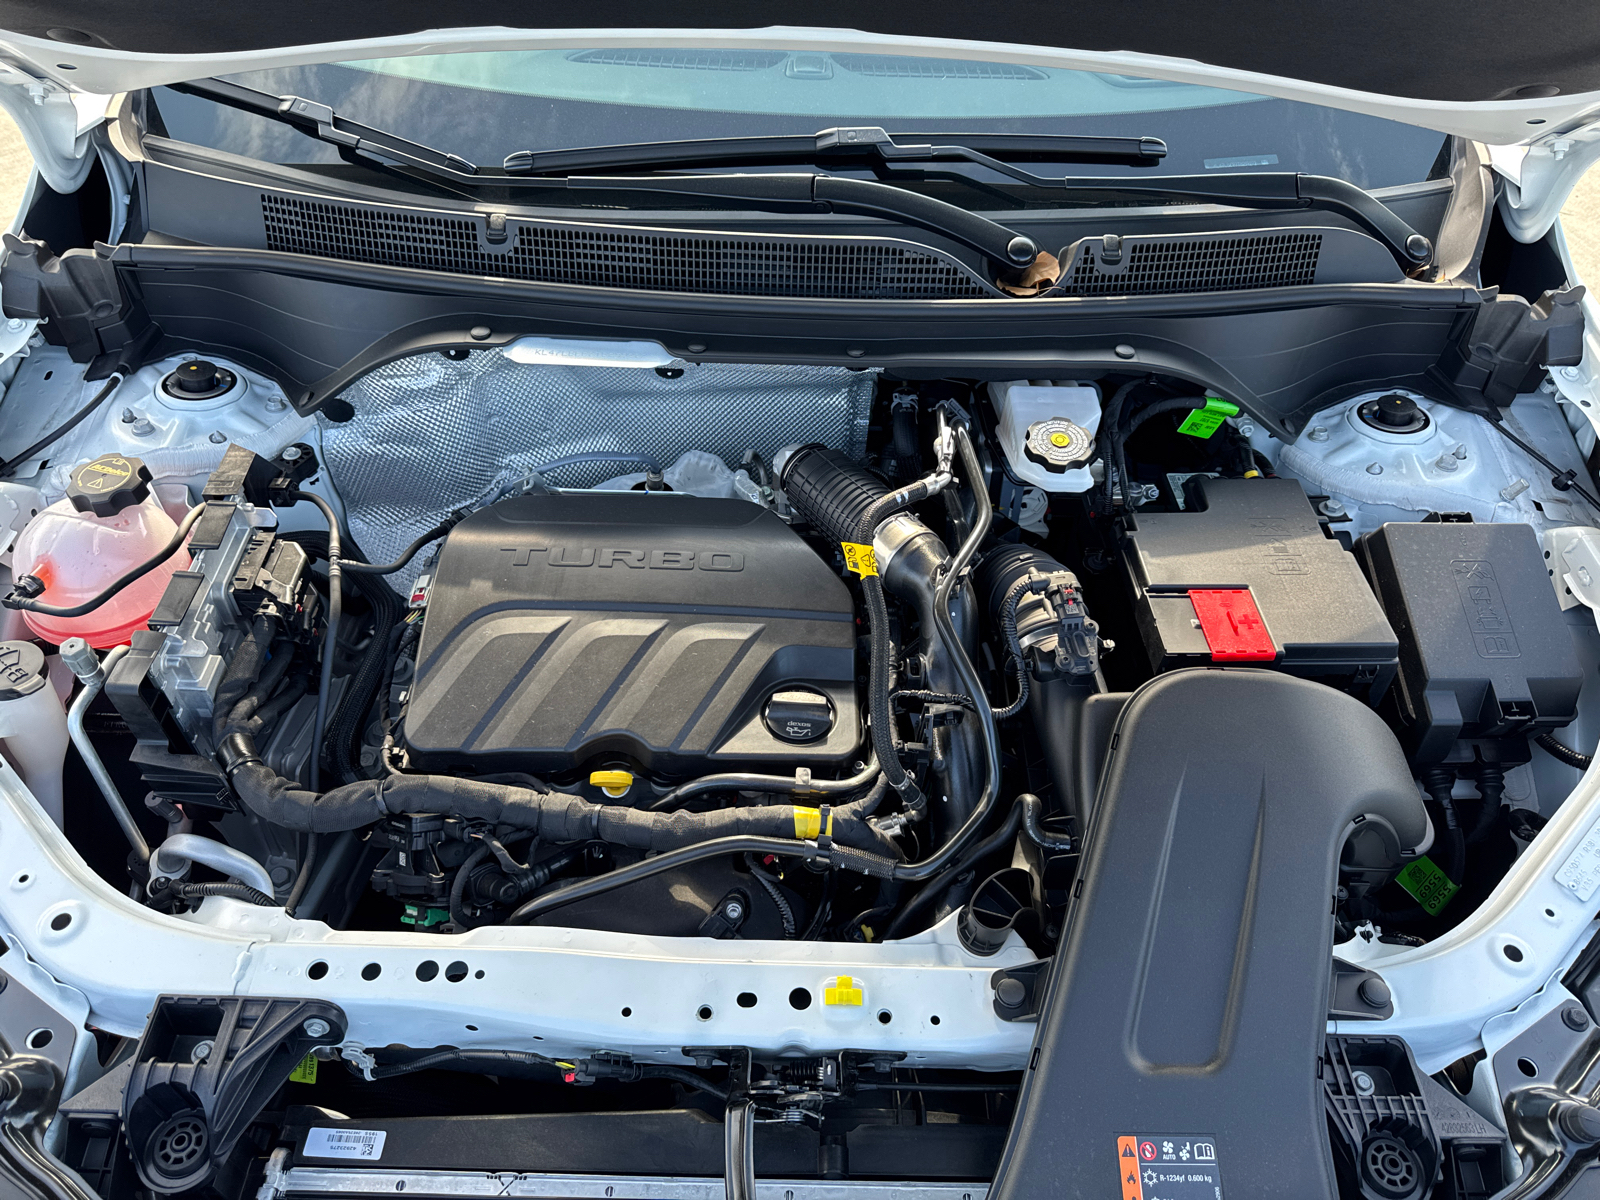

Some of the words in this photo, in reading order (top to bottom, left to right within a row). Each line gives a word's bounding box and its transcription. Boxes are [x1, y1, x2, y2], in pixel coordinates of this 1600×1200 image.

[90, 463, 130, 477] ACDelco
[500, 547, 745, 572] TURBO
[787, 720, 812, 728] dexos
[1419, 873, 1441, 899] 5569
[1428, 884, 1451, 909] 5569
[1159, 1174, 1185, 1182] R-1234yf
[1188, 1174, 1203, 1182] 0.600
[1204, 1174, 1212, 1183] kg
